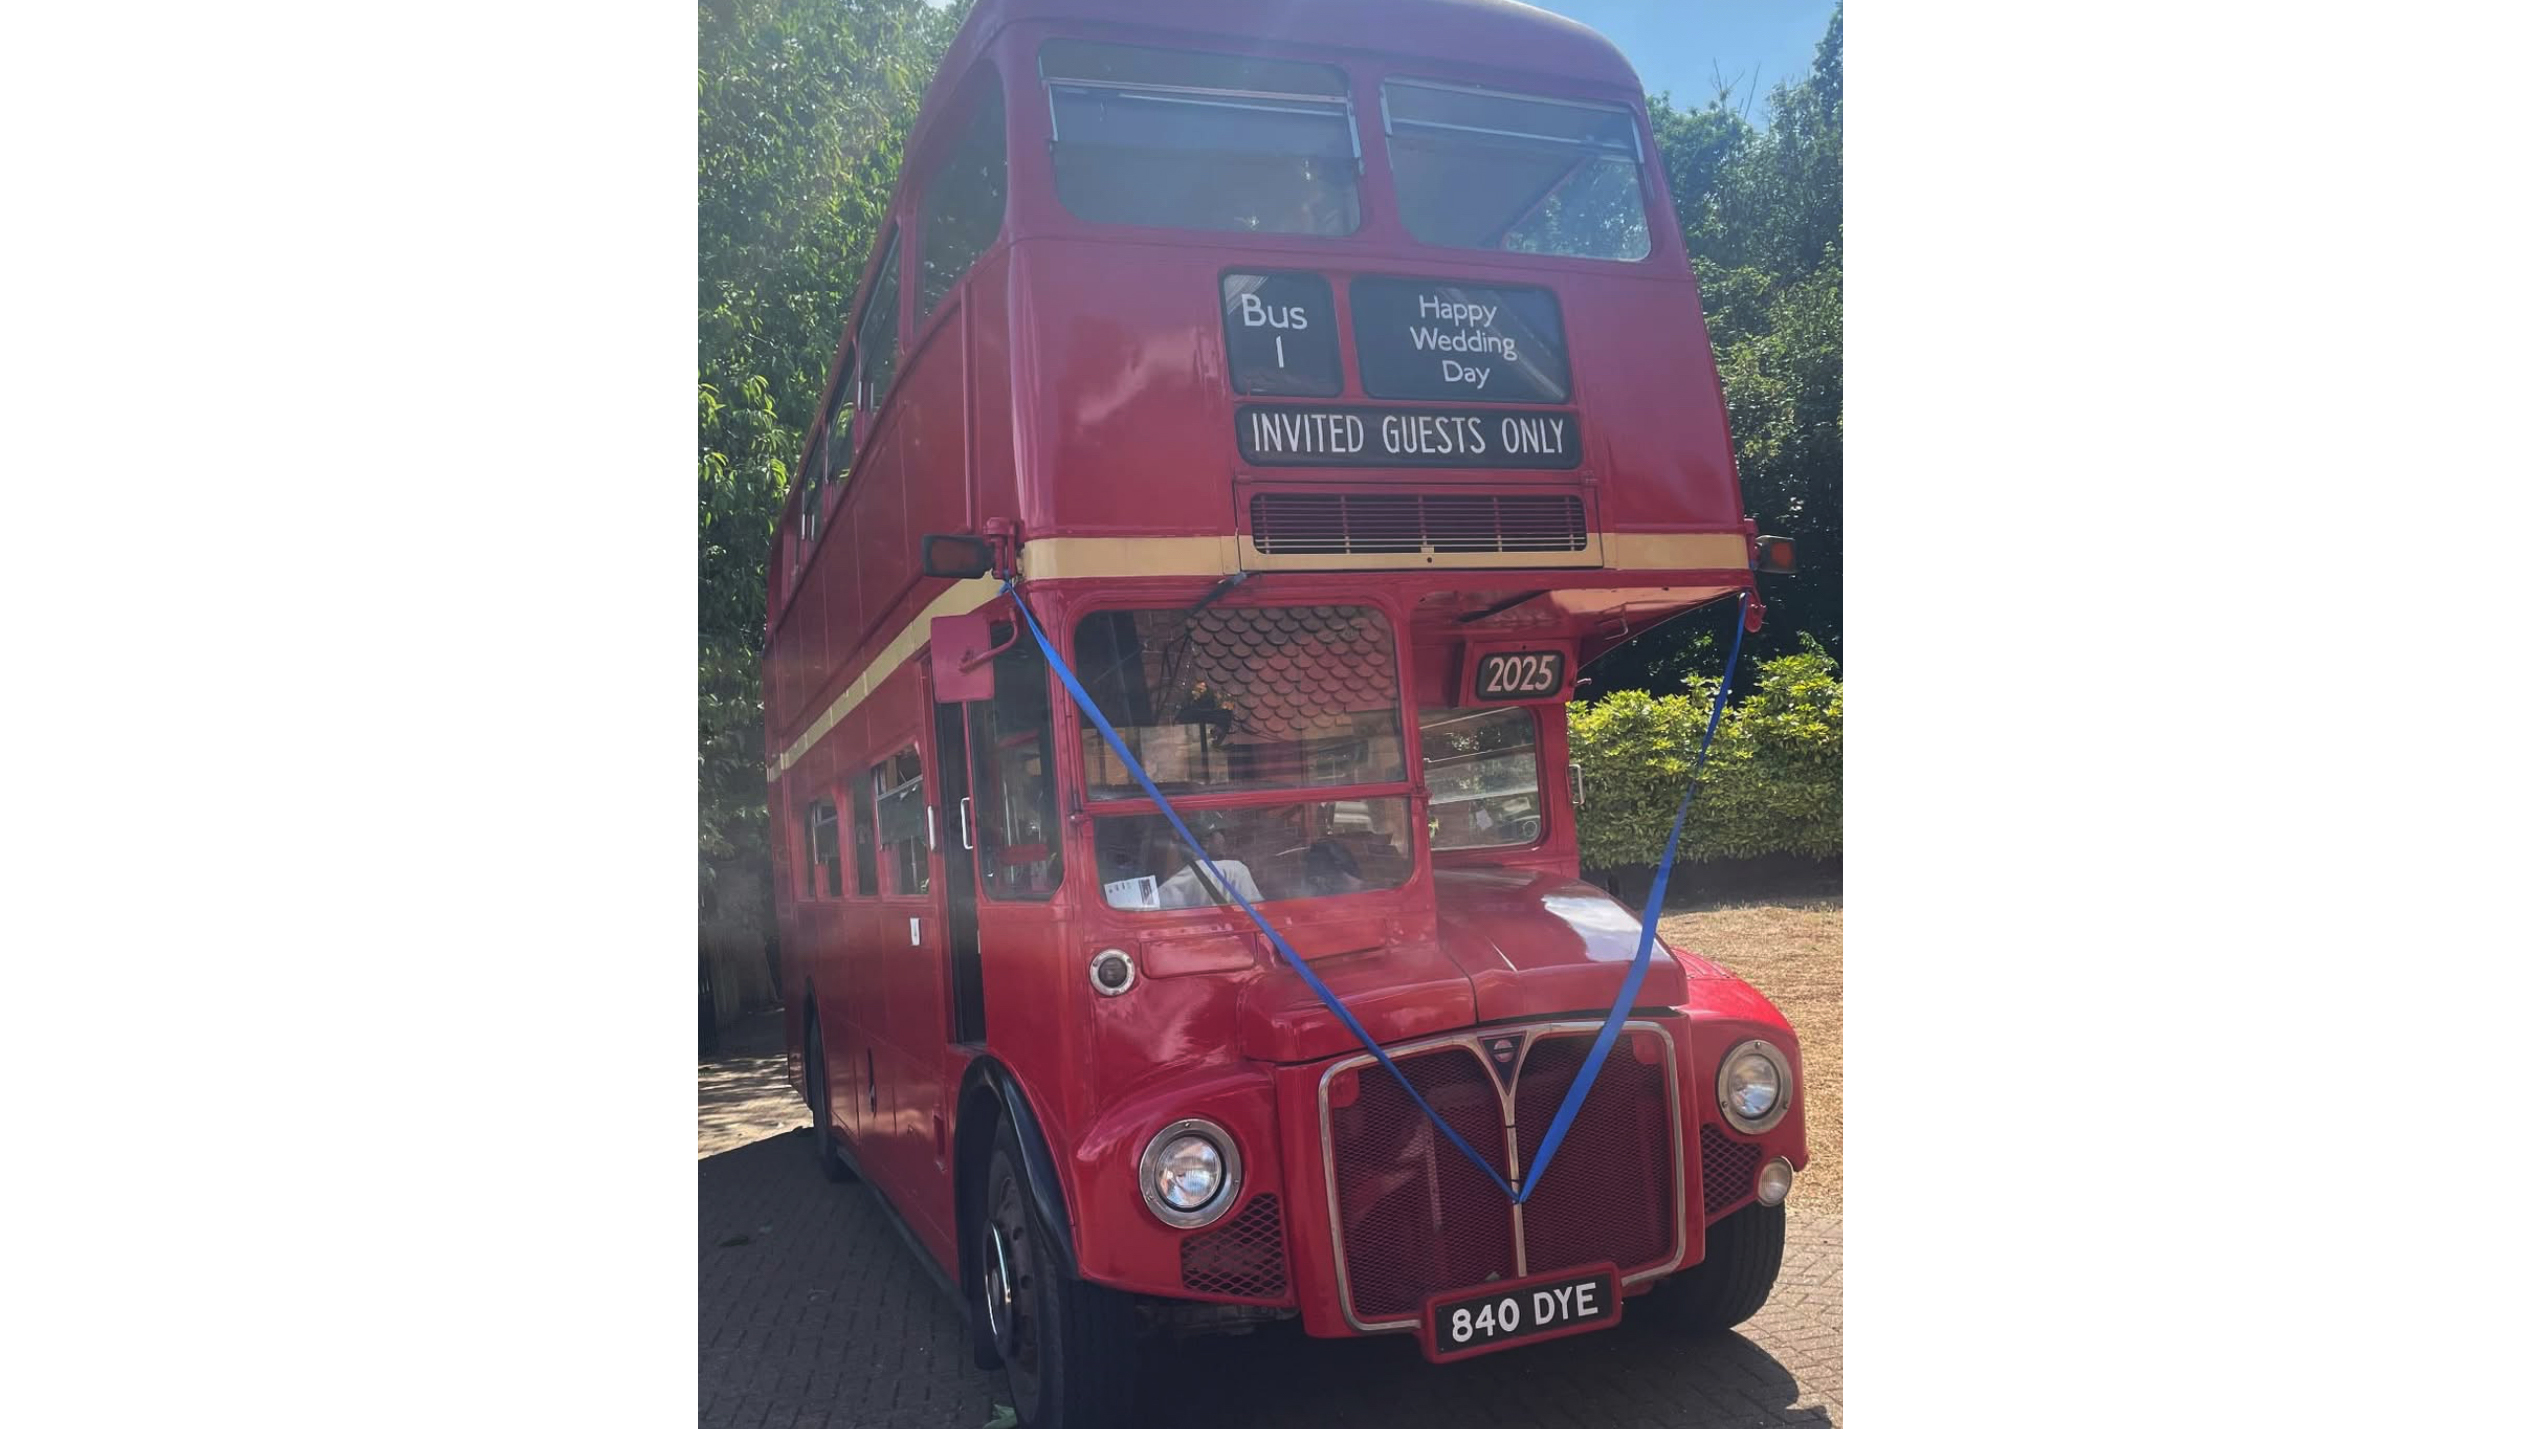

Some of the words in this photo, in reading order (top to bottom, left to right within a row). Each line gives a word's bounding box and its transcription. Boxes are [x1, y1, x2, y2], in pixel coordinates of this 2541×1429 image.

[1242, 293, 1308, 330] Bus
[1418, 295, 1497, 327] Happy
[1409, 326, 1518, 361] Wedding
[1442, 360, 1491, 389] Day
[1251, 413, 1364, 453] INVITED
[1382, 415, 1486, 454] GUESTS
[1502, 418, 1563, 454] ONLY
[1486, 655, 1557, 692] 2025
[1452, 1298, 1520, 1342] 840
[1533, 1282, 1599, 1326] DYE
